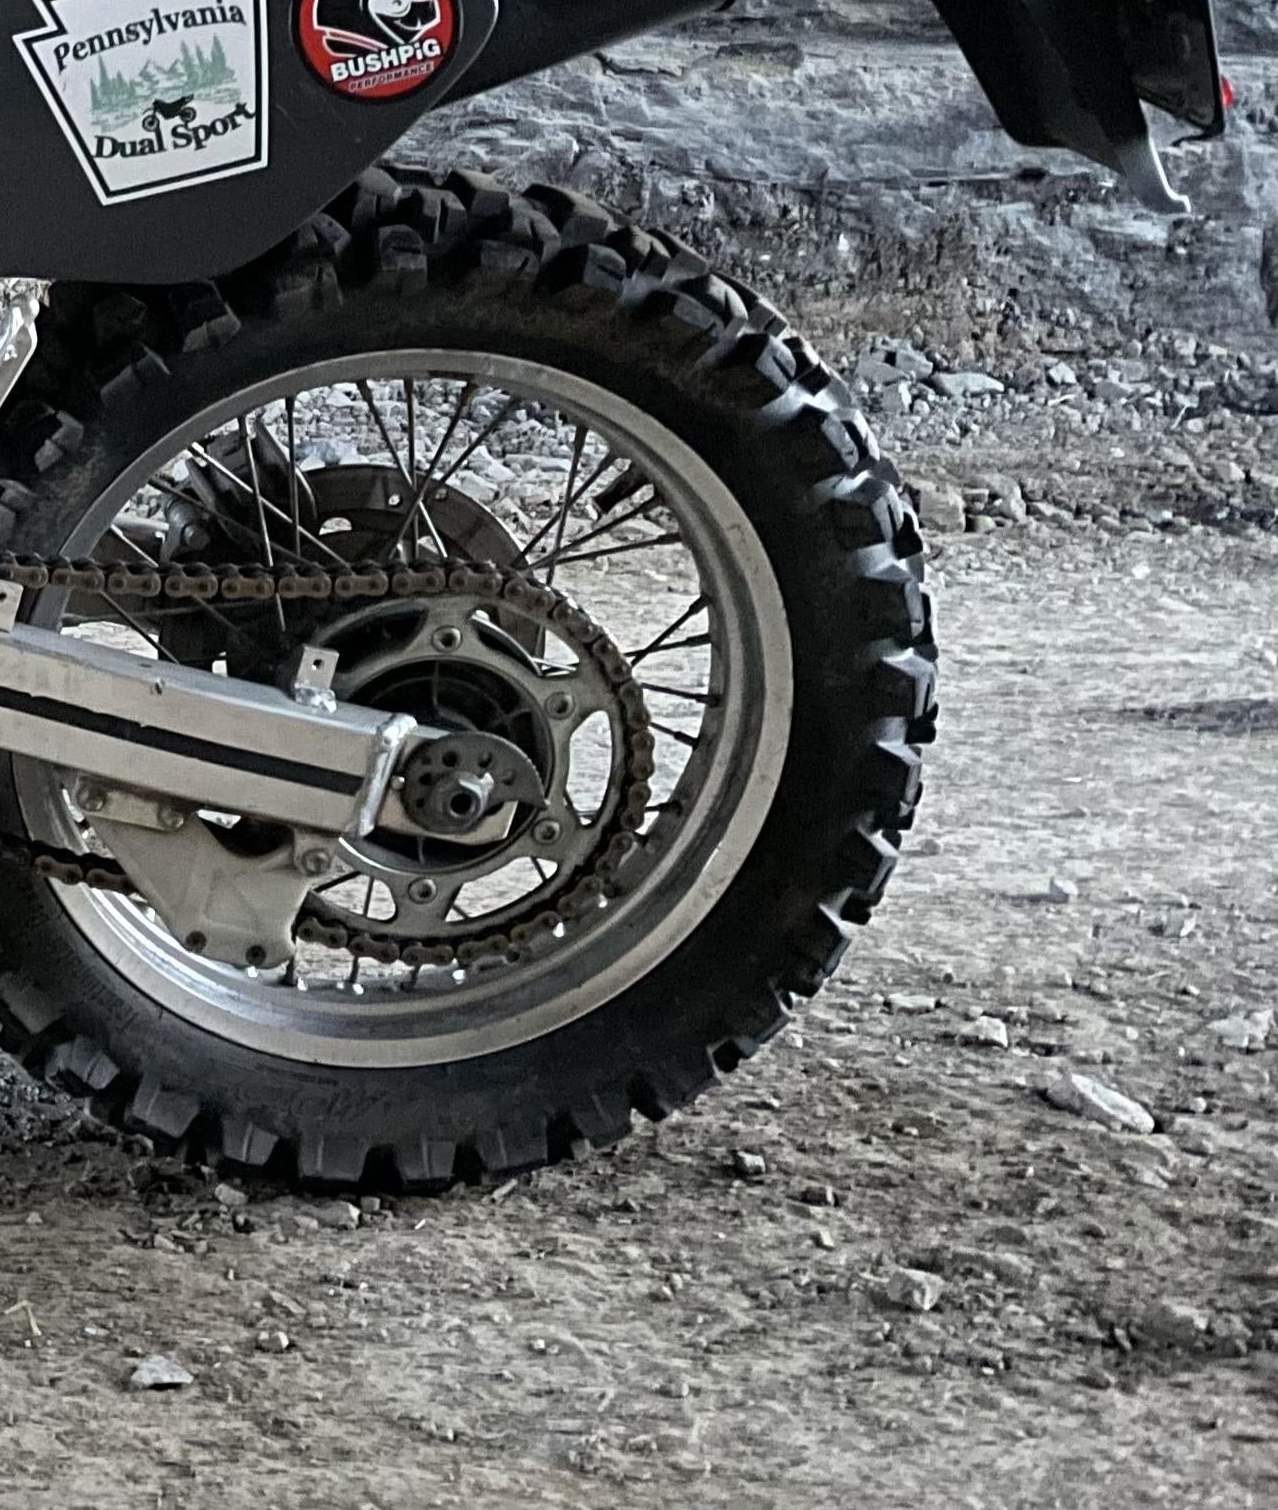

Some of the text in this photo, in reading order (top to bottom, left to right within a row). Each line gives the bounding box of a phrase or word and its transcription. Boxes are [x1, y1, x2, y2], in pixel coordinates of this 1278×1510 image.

[349, 61, 435, 93] PERFORMANCE
[94, 102, 256, 159] Dual Sport
